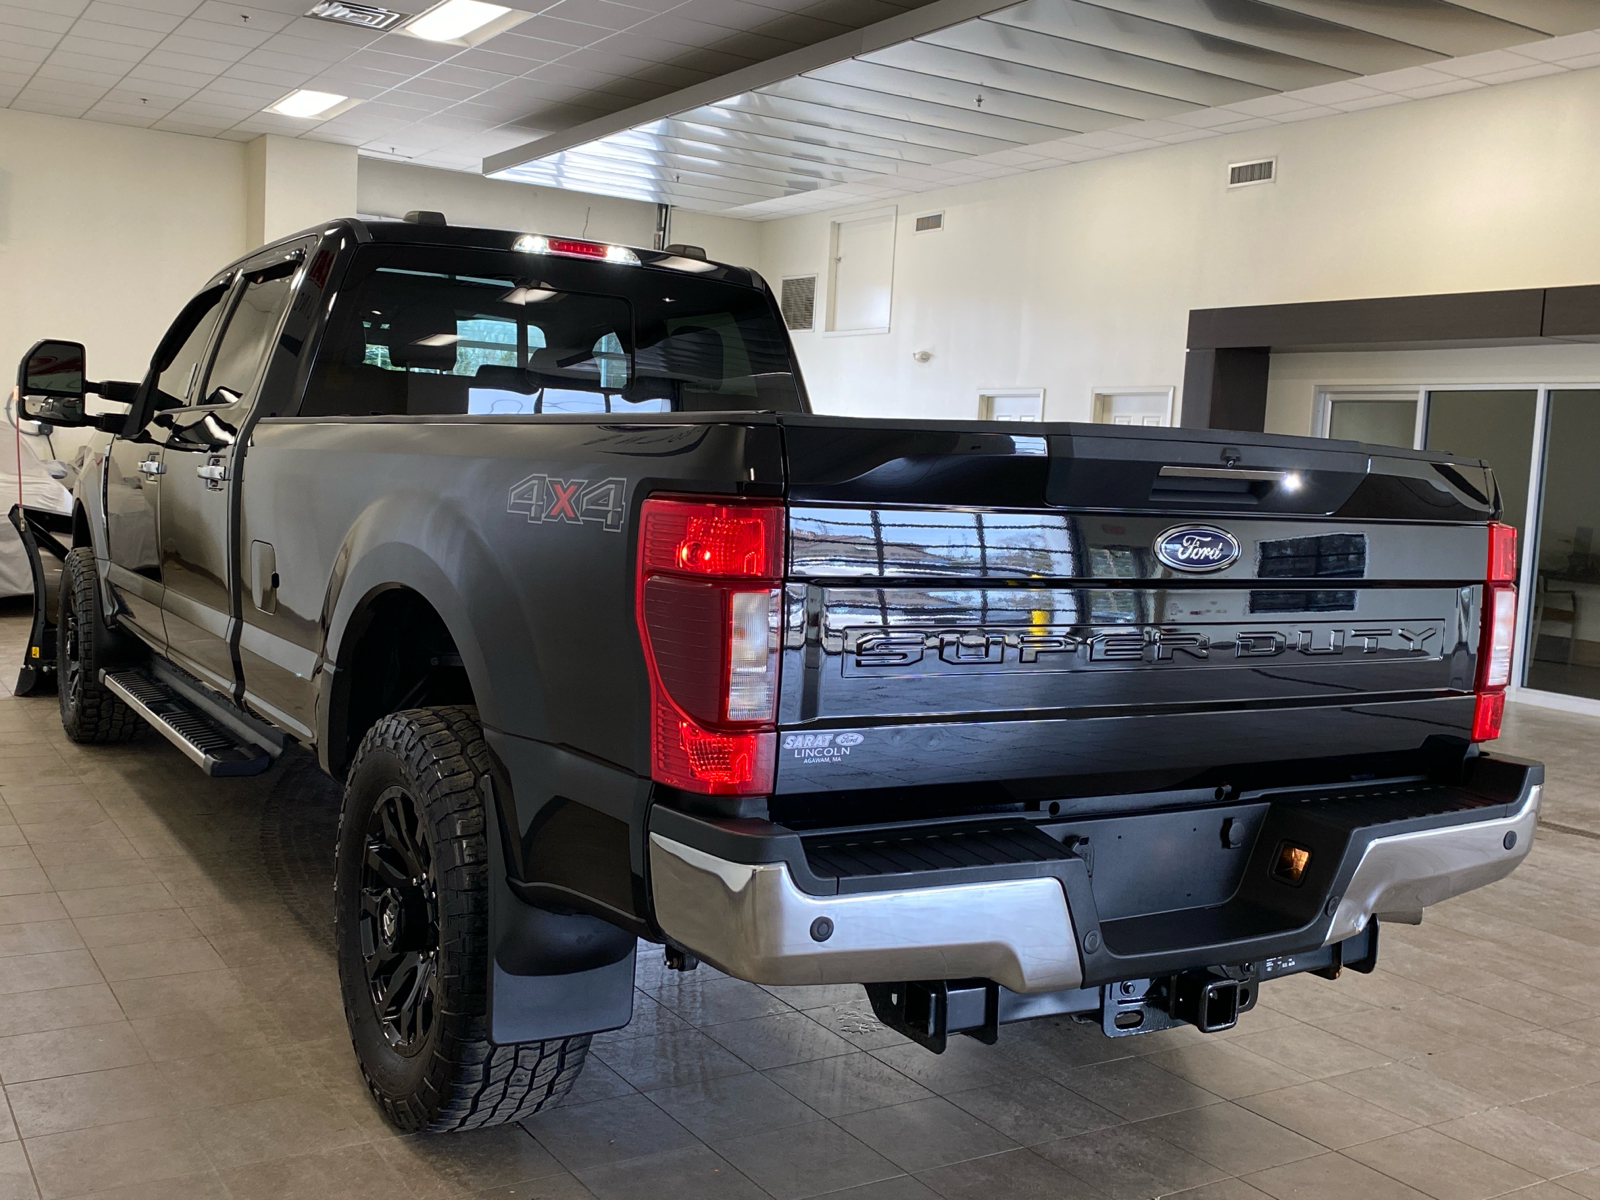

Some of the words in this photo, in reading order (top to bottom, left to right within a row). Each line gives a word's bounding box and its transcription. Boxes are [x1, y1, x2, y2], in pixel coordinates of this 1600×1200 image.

[1177, 535, 1223, 560] Ford
[855, 634, 1211, 667] SUPER
[1235, 627, 1437, 658] DUTY
[783, 734, 834, 749] SARAT
[794, 747, 850, 758] LINCOLN
